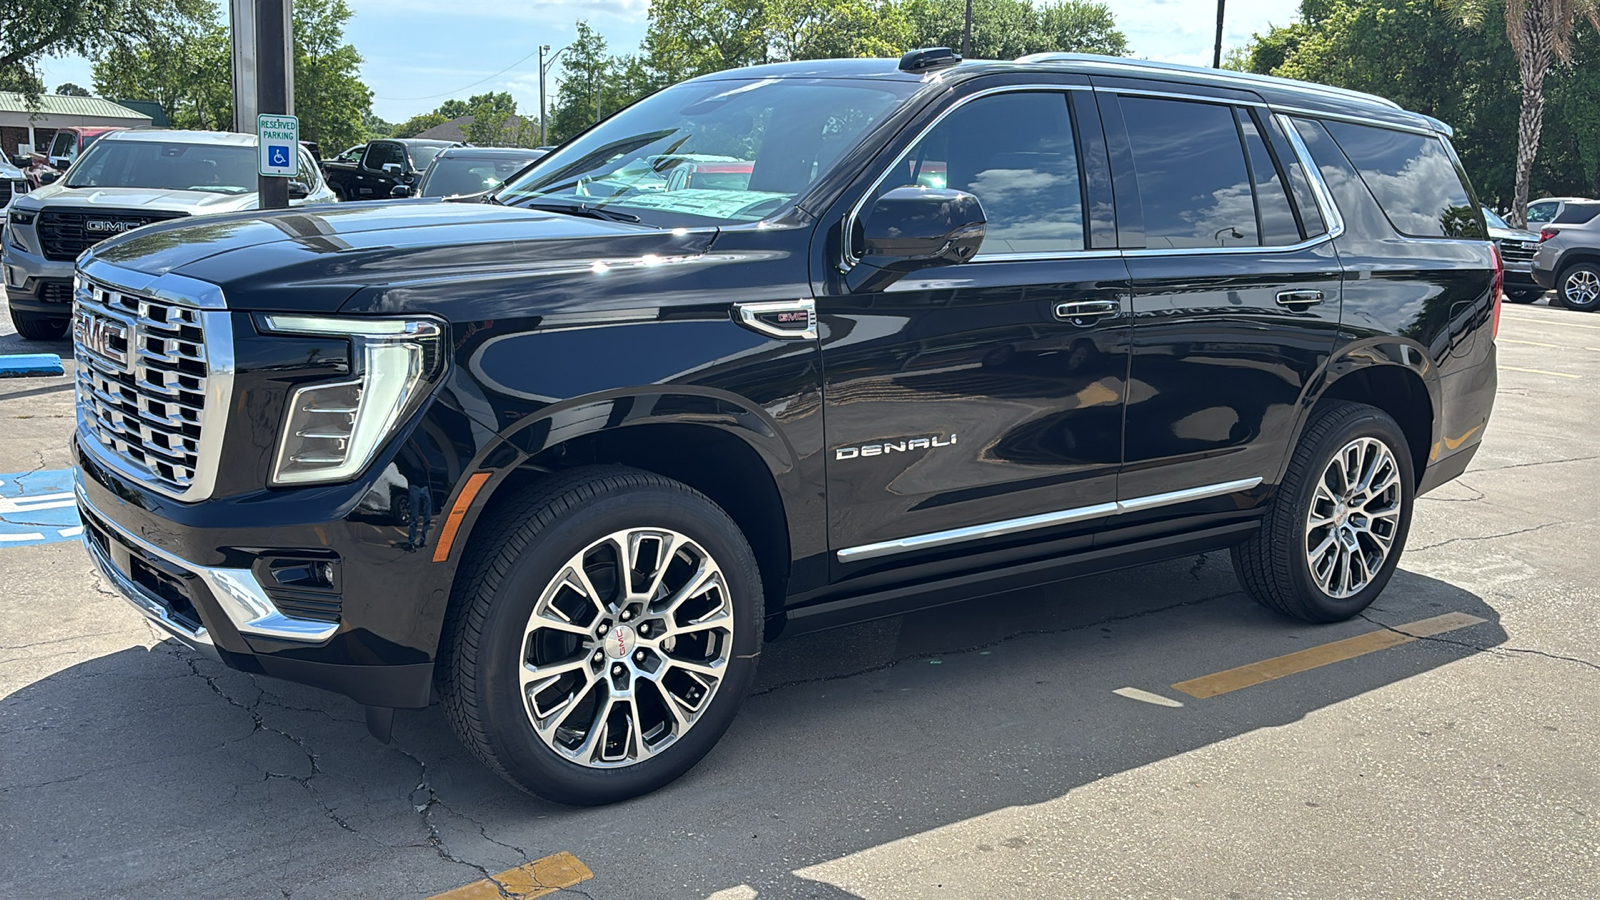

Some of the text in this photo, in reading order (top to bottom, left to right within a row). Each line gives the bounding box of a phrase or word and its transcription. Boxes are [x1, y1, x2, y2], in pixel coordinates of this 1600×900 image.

[261, 120, 295, 130] RESERVED
[263, 131, 294, 140] PARKING
[86, 220, 140, 231] GMC
[778, 312, 807, 322] GMC
[74, 310, 128, 364] GMC
[836, 433, 957, 460] DENALI
[615, 628, 626, 656] GMC
